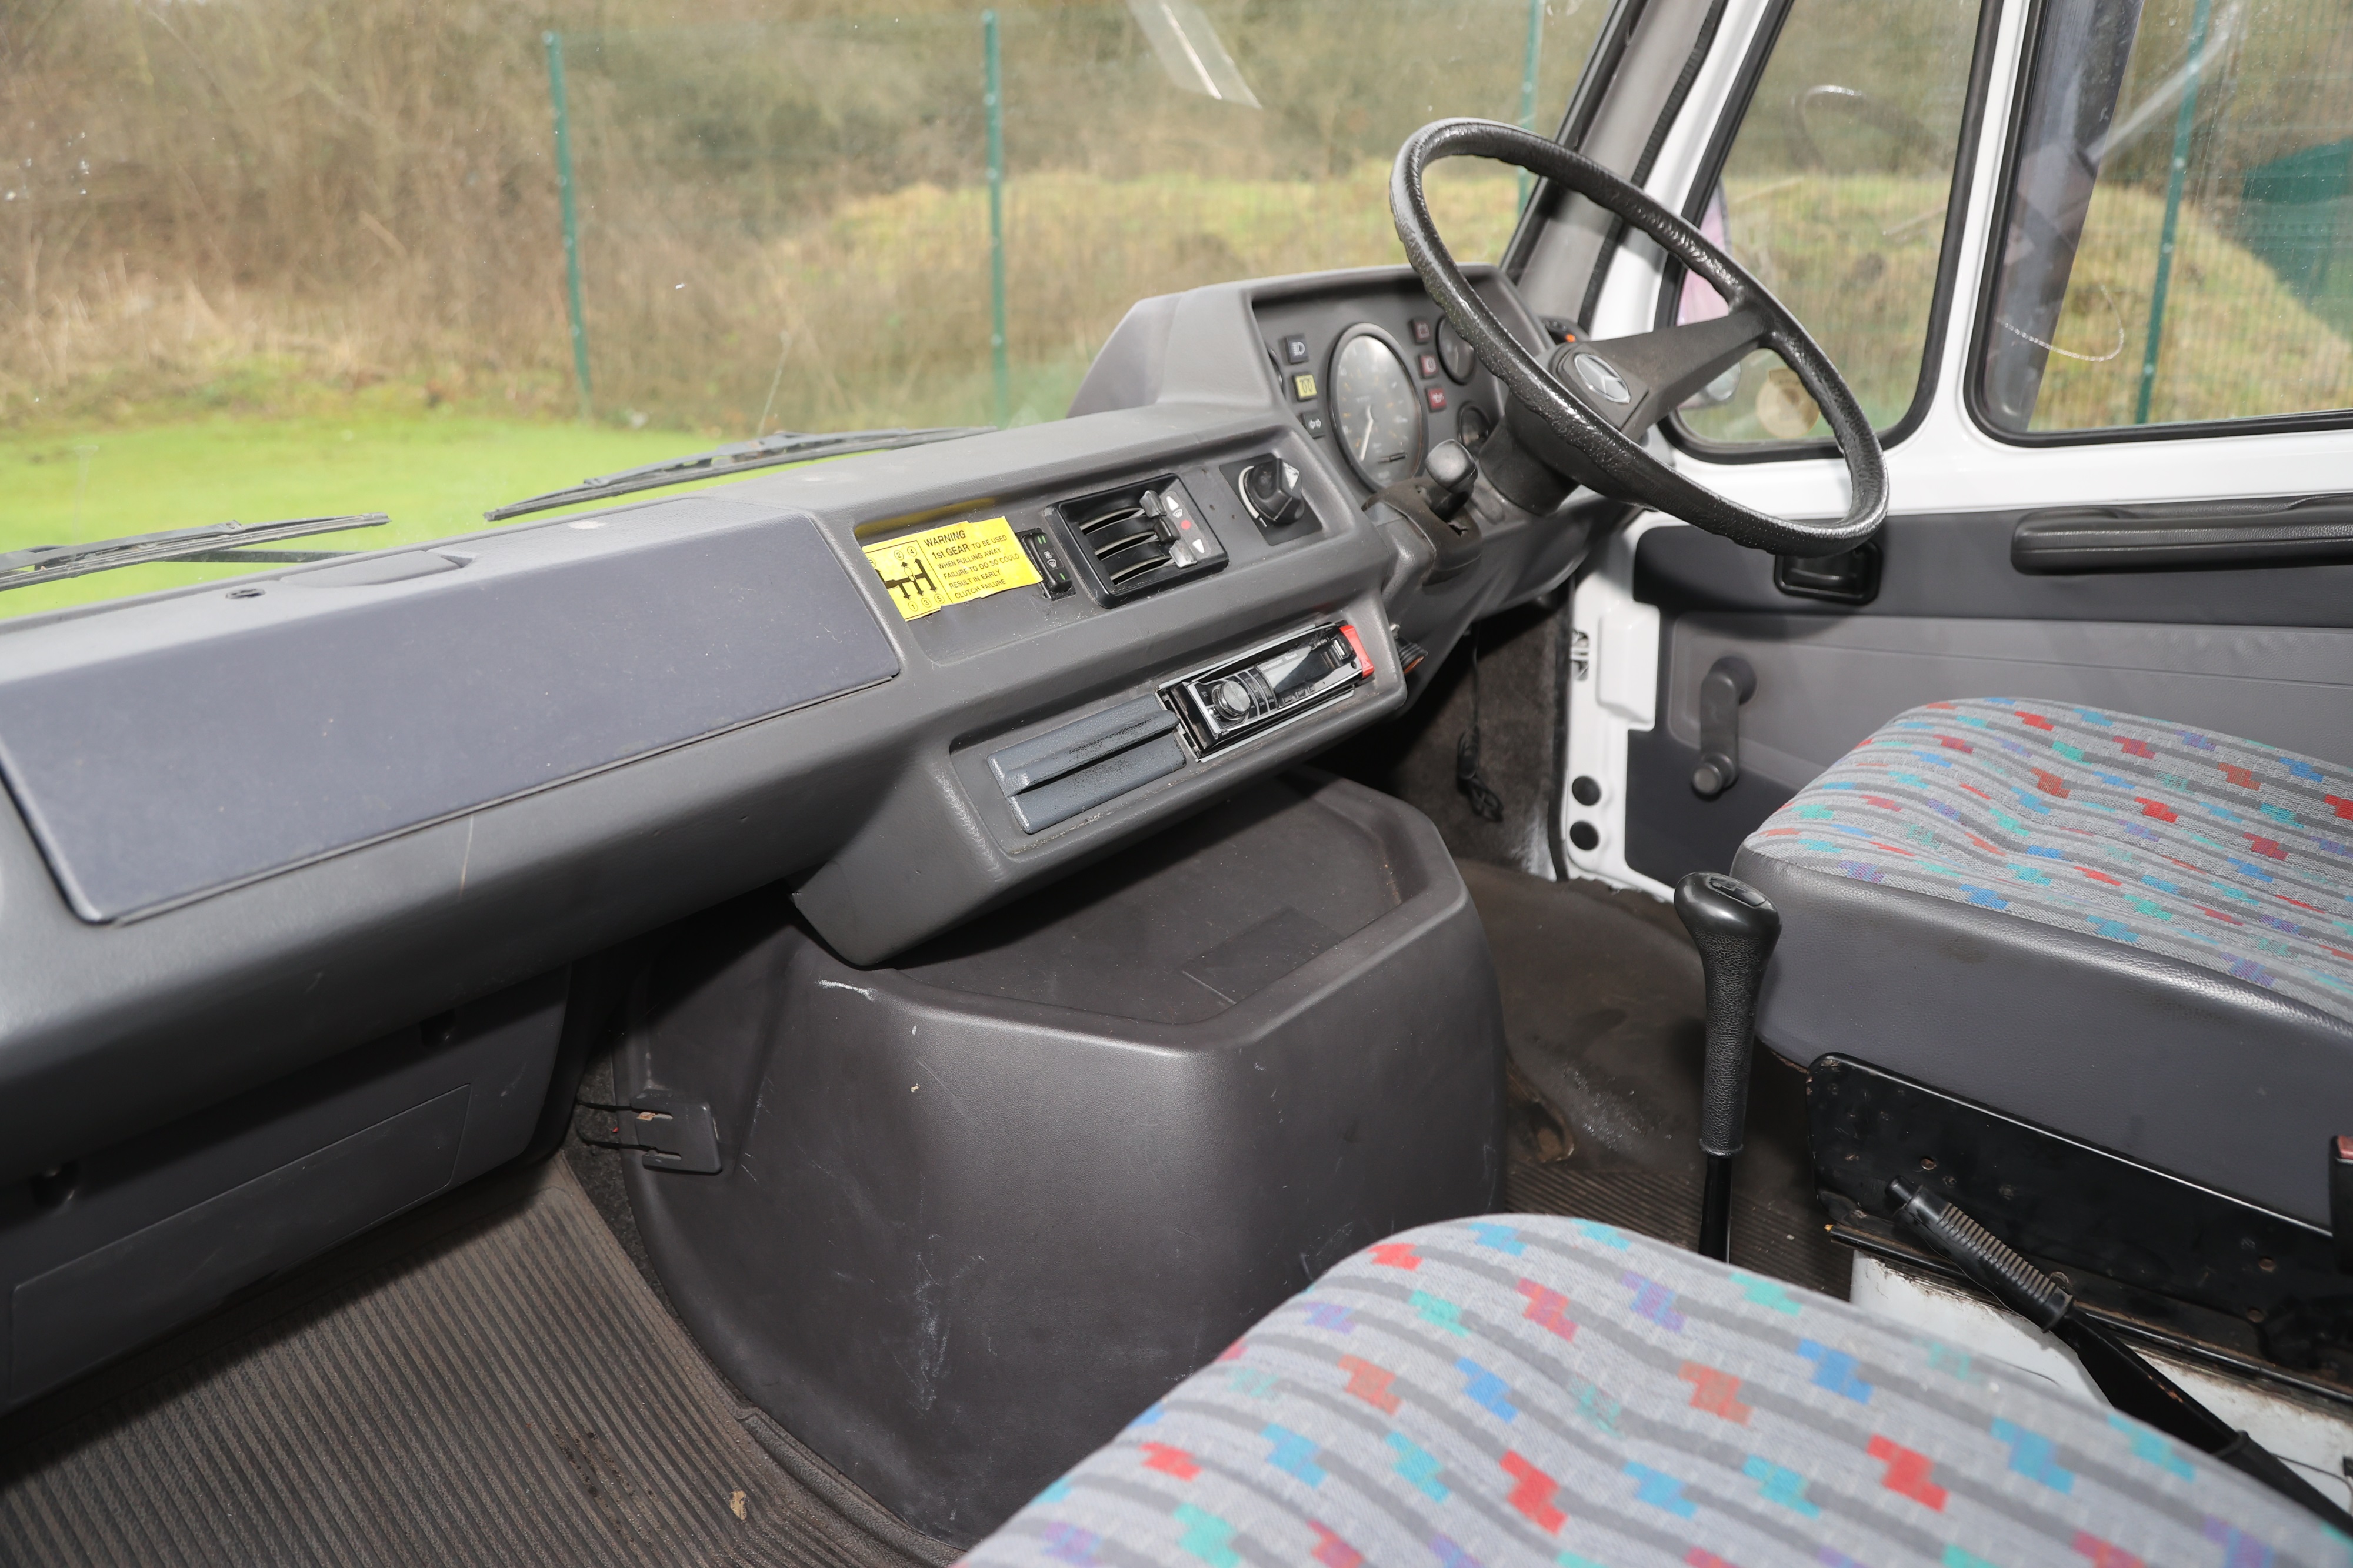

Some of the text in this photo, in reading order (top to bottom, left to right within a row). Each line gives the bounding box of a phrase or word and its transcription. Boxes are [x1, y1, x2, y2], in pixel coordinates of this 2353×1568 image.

[924, 530, 966, 547] WARNING
[932, 550, 945, 559] 1st
[946, 543, 971, 556] GEAR
[991, 535, 1007, 543] USED
[937, 547, 1001, 569] WHEN PULLING AWAY
[943, 568, 969, 579] FAILURE
[999, 553, 1019, 563] COULD
[949, 578, 972, 589] RESULT
[981, 569, 1001, 579] EARLY
[955, 579, 1006, 599] CLUTCH FAILURE
